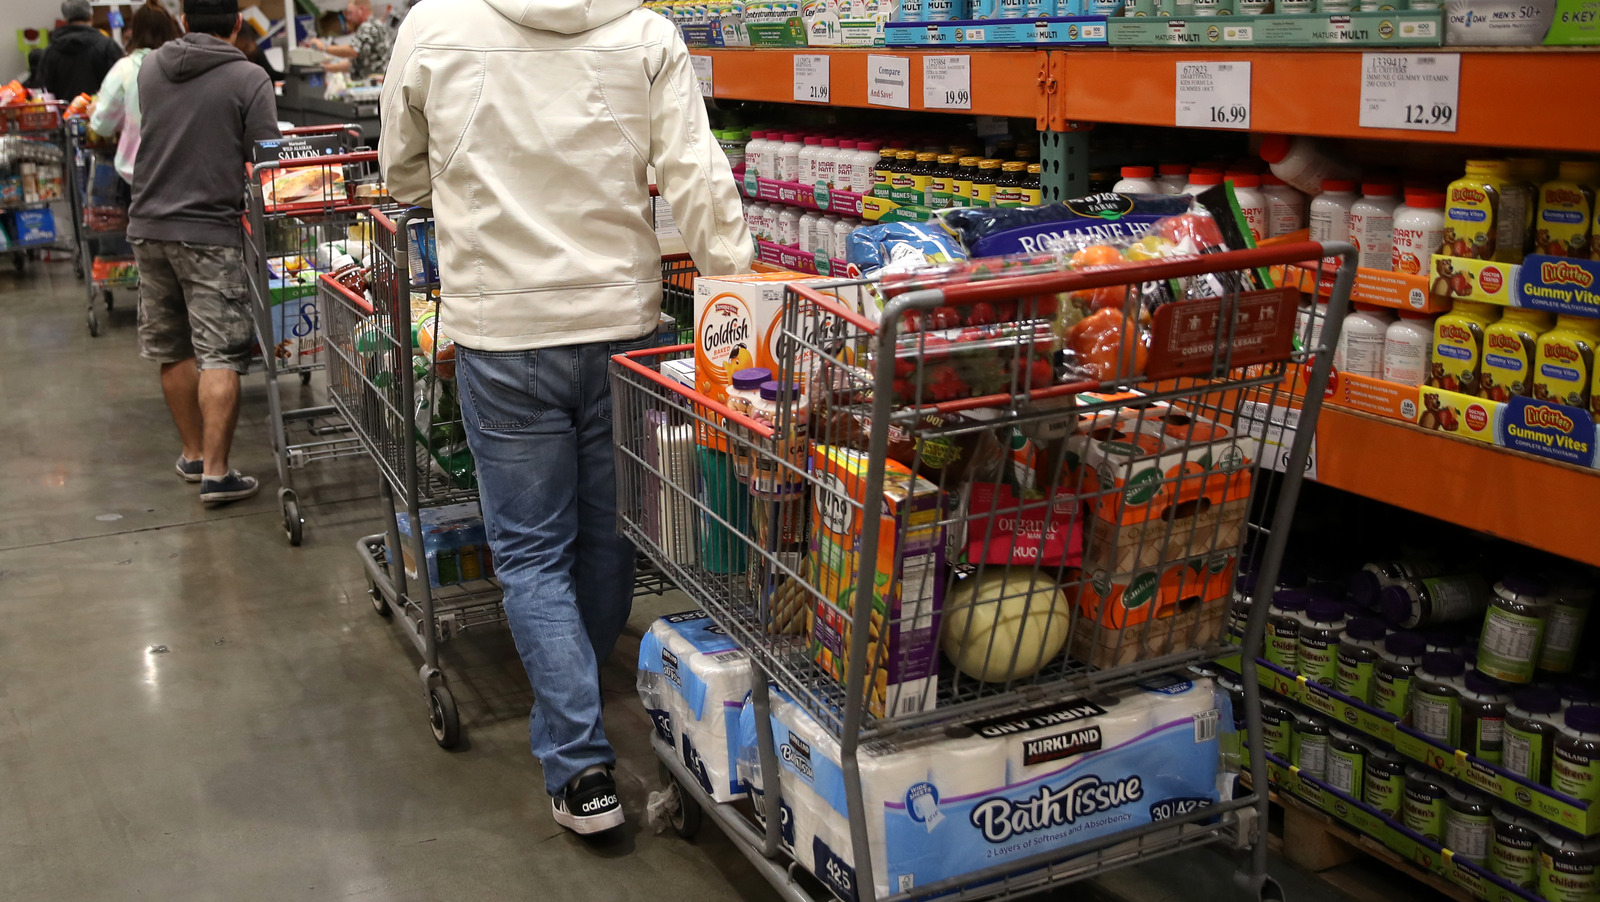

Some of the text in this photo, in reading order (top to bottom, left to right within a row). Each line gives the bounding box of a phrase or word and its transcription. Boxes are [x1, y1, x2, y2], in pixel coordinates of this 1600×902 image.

[1519, 6, 1540, 18] 50+
[1562, 11, 1596, 22] 6 KEY
[811, 25, 827, 34] Centrum
[1340, 30, 1368, 40] MULTI
[1372, 58, 1408, 68] 1339412
[878, 66, 900, 76] Compare
[1183, 66, 1207, 74] 677823
[810, 86, 828, 98] 21.99
[870, 90, 894, 99] And Save!
[945, 92, 968, 104] 19.99
[1210, 106, 1246, 122] 16.99
[1404, 104, 1452, 124] 12.99
[278, 150, 320, 160] SALMON
[1393, 228, 1423, 238] MARTY
[1393, 238, 1412, 247] ANTS
[1557, 262, 1590, 283] Critters
[1524, 283, 1600, 304] Gummy Vite
[1532, 298, 1598, 313] COMPLETE MULTIVITAMIN
[704, 318, 748, 351] Goldfish
[714, 346, 730, 356] BAKED
[1182, 345, 1214, 354] COSTCO
[1439, 346, 1470, 356] Gummy Vites
[1487, 356, 1520, 367] Gummy Vites
[1543, 366, 1577, 378] Gummy Vites
[1538, 407, 1571, 430] Critters
[1508, 425, 1588, 452] Gummy Vites
[1515, 440, 1578, 458] COMPLETE MULTIVITAMIN
[1306, 694, 1334, 712] Children's
[982, 704, 1097, 736] KIRKLAND
[1028, 728, 1099, 756] KIRKLAND
[1466, 770, 1502, 791] Children's
[910, 784, 927, 793] WIDE
[910, 788, 932, 800] SHEETS
[1298, 784, 1325, 804] Children's
[582, 794, 618, 812] adidas
[986, 812, 1132, 858] 2 Layers of Softness and Absorbency
[1496, 834, 1532, 848] KIRKLAND
[1556, 862, 1592, 871] KIRKLAND
[826, 858, 850, 890] 425
[1452, 870, 1487, 893] Children's
